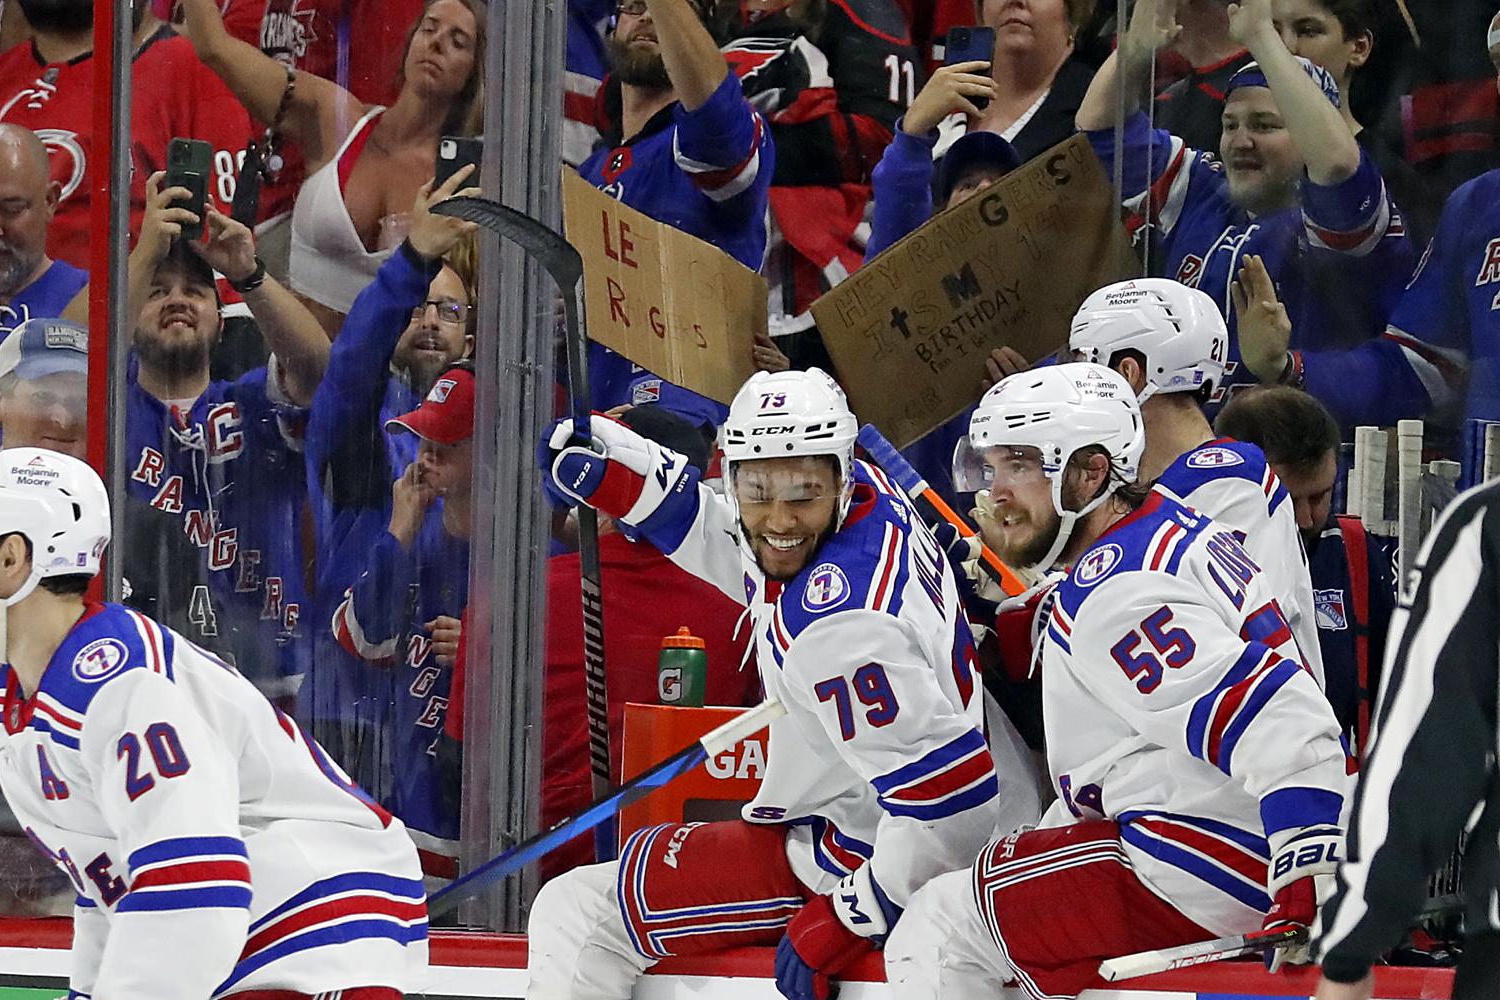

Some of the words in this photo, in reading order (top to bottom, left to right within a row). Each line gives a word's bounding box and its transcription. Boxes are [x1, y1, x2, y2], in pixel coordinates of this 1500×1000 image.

[884, 54, 915, 108] 11
[602, 210, 638, 269] LE
[915, 280, 1023, 364] BIRTHDAY
[1211, 338, 1224, 362] 21
[207, 402, 245, 464] C
[751, 425, 796, 436] CCM
[11, 466, 60, 479] Benjamin
[17, 476, 52, 487] Moore
[1110, 605, 1197, 694] 55
[659, 667, 682, 702] G
[814, 662, 900, 741] 79
[117, 721, 191, 802] 20
[705, 739, 770, 780] GA
